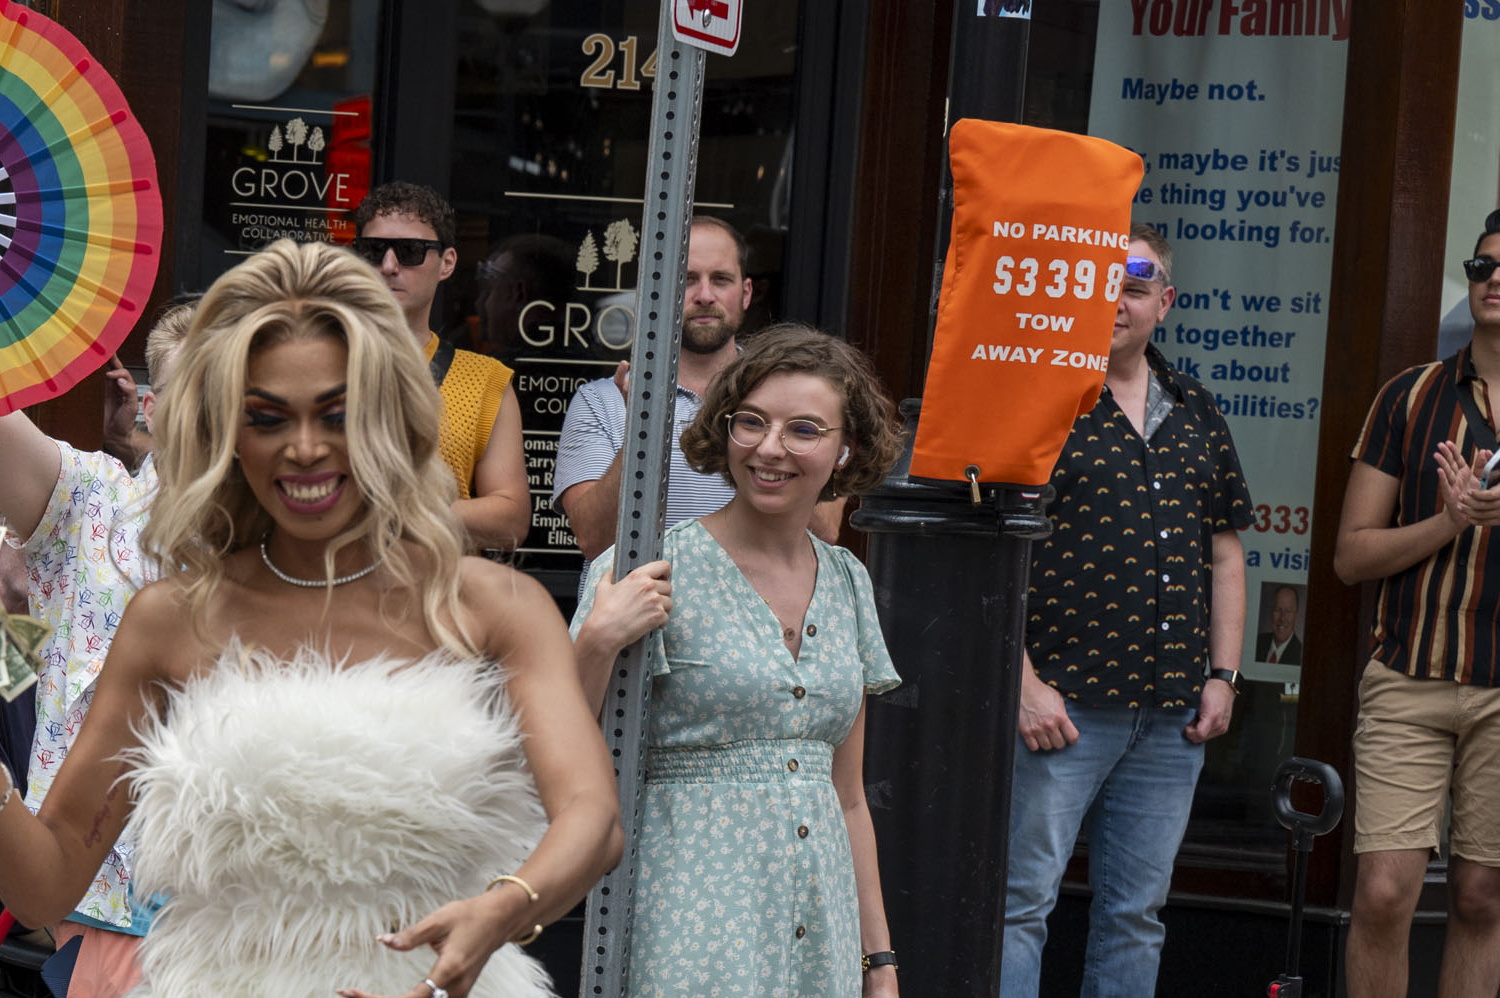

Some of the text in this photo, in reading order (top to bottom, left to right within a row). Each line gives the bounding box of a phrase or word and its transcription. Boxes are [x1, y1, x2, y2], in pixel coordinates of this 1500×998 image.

[1121, 78, 1265, 105] Maybe not.
[1158, 149, 1248, 175] maybe
[1258, 149, 1301, 173] it's
[1307, 150, 1341, 178] jus
[232, 167, 350, 202] GROVE
[1160, 183, 1226, 211] thing
[1236, 185, 1326, 212] you've
[232, 213, 347, 230] EMOTIONAL HEALTH
[242, 227, 335, 243] COLLABORATIVE
[1176, 217, 1281, 248] looking
[1289, 220, 1330, 244] for.
[993, 221, 1025, 238] NO
[1032, 223, 1129, 250] PARKING
[1170, 288, 1322, 314] on't we sit
[518, 300, 636, 350] GRO
[1015, 313, 1075, 332] TOW
[1175, 323, 1296, 351] together
[971, 344, 1108, 372] AWAY ZONE
[1211, 359, 1290, 383] about
[519, 375, 589, 393] EMOTIO
[1216, 393, 1320, 420] bilities?
[524, 438, 560, 451] omas
[1238, 504, 1309, 536] 333
[1246, 547, 1310, 571] a visi
